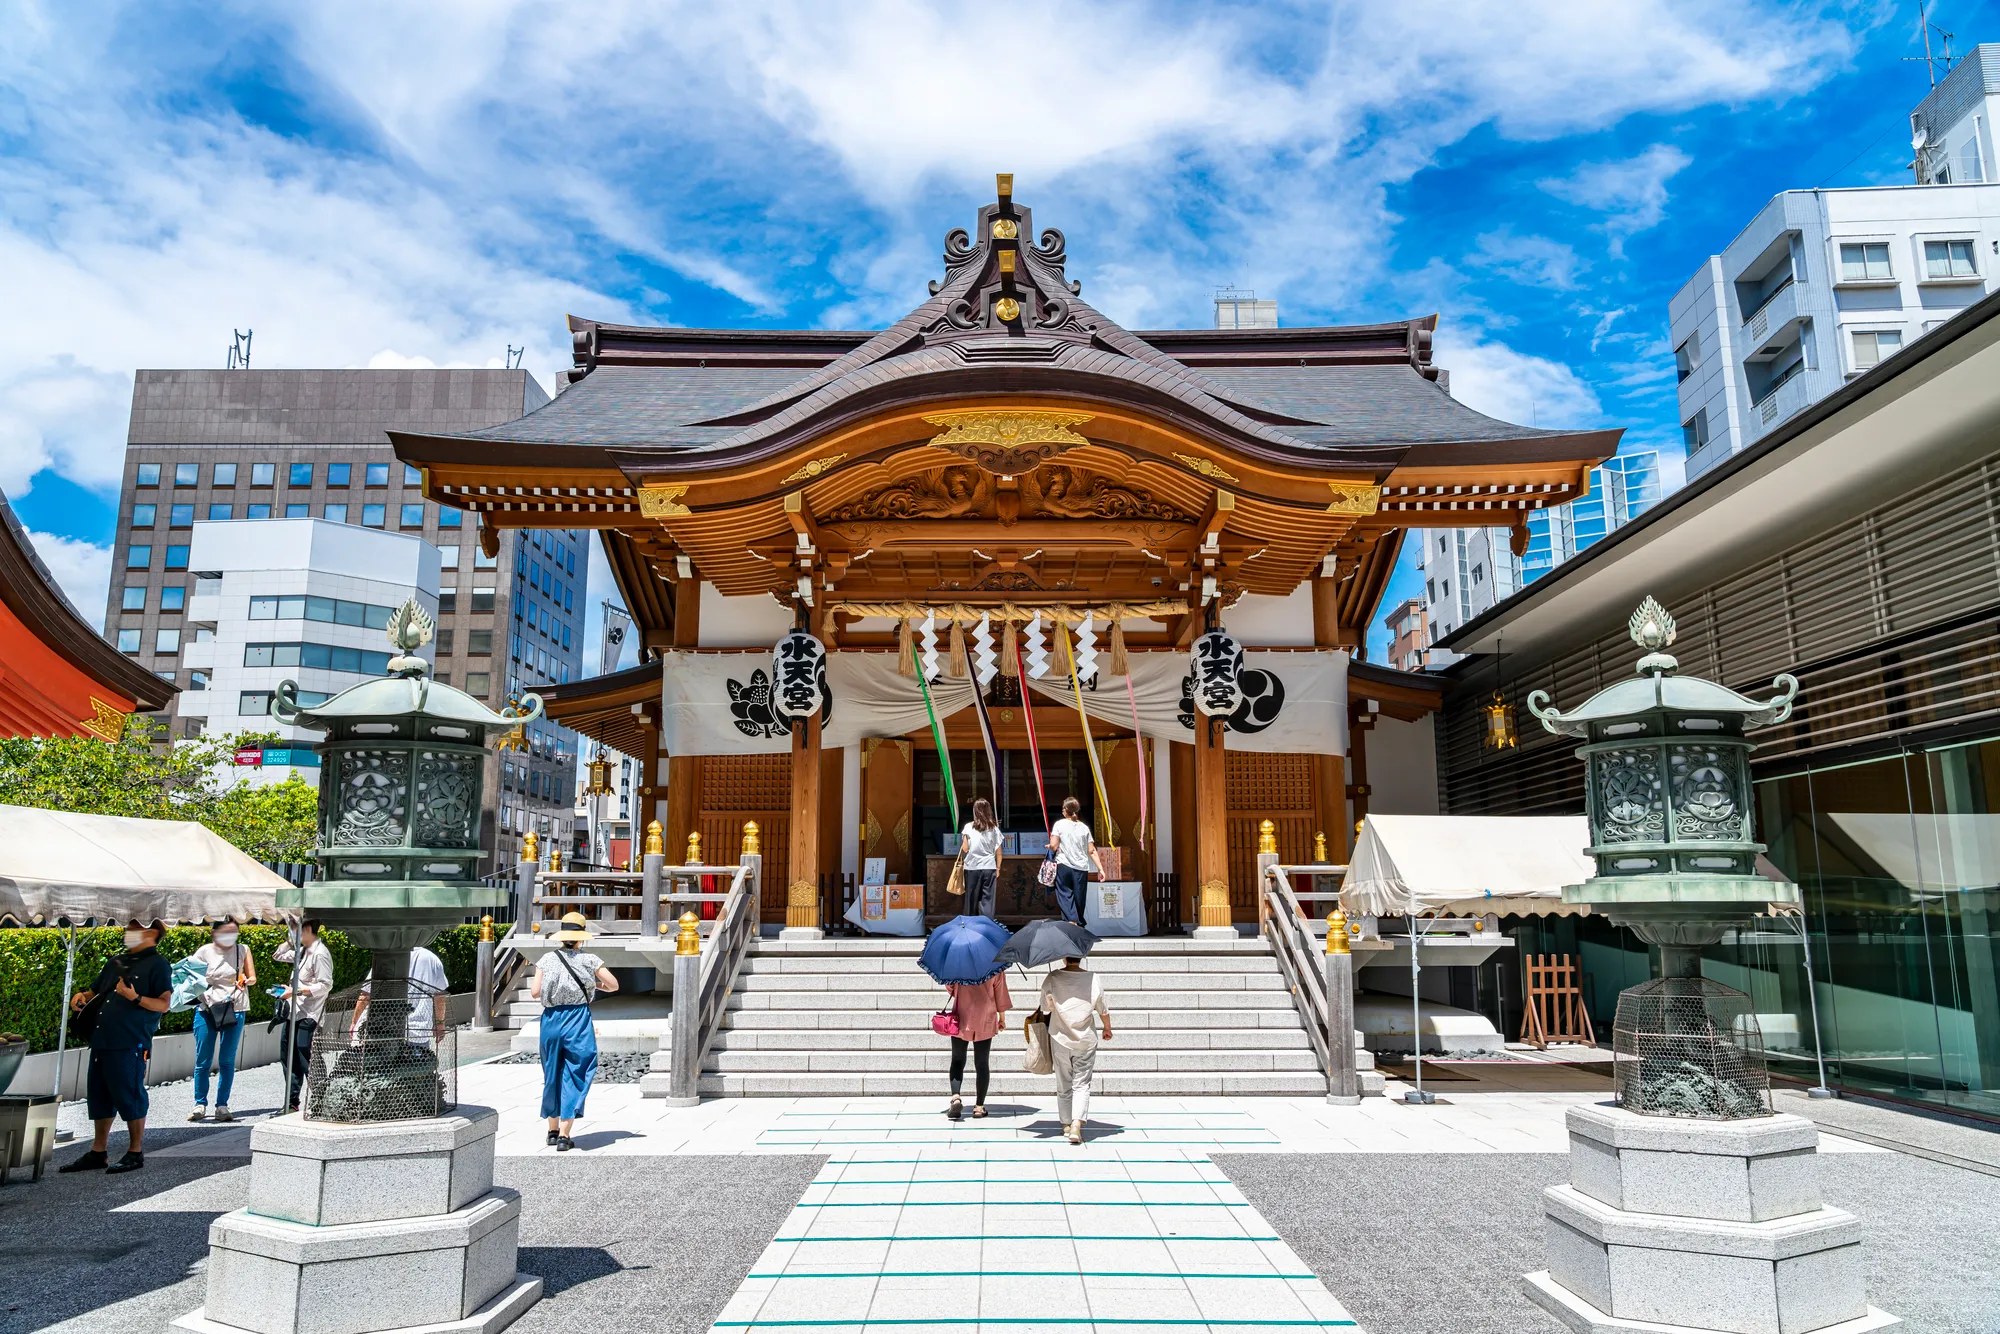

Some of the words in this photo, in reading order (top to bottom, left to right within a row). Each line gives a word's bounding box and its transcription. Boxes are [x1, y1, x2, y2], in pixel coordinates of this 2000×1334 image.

[781, 635, 818, 711] 水天宮
[1198, 634, 1236, 709] 水天宮
